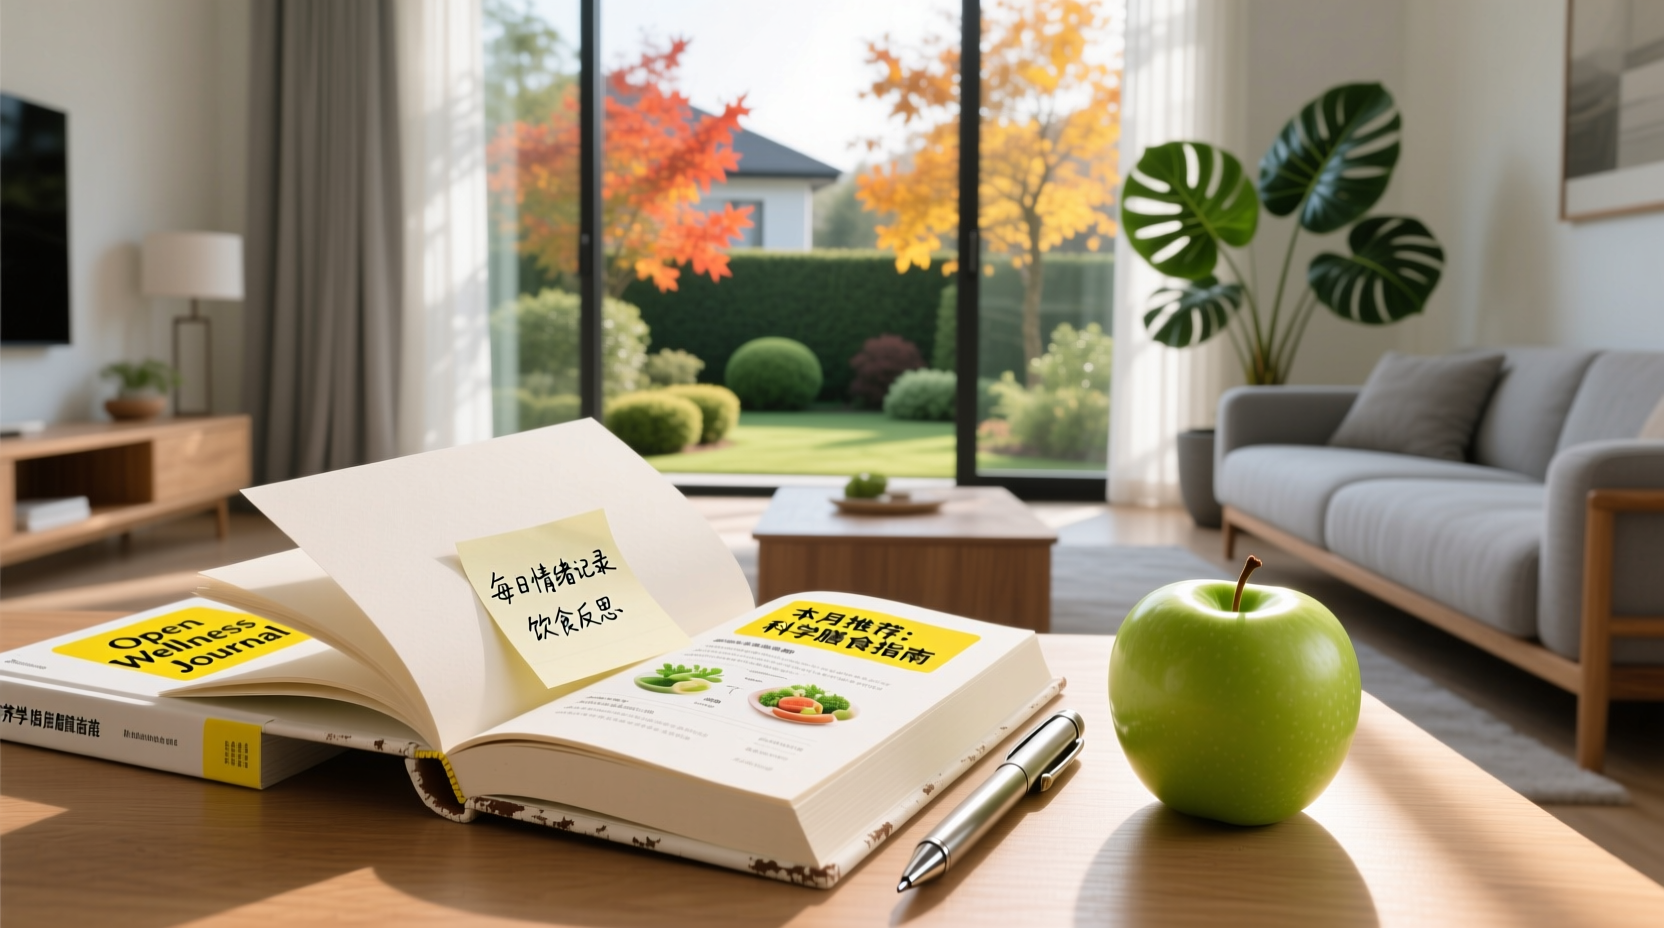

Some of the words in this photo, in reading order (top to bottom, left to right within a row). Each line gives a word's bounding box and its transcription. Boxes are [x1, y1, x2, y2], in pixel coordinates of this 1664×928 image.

[491, 549, 616, 604] 每日情绪记录
[108, 619, 204, 650] Open
[528, 596, 623, 641] 饮食反思
[109, 619, 256, 669] Wellness
[172, 626, 291, 673] Journal
[762, 620, 935, 666] 科学膳食指南
